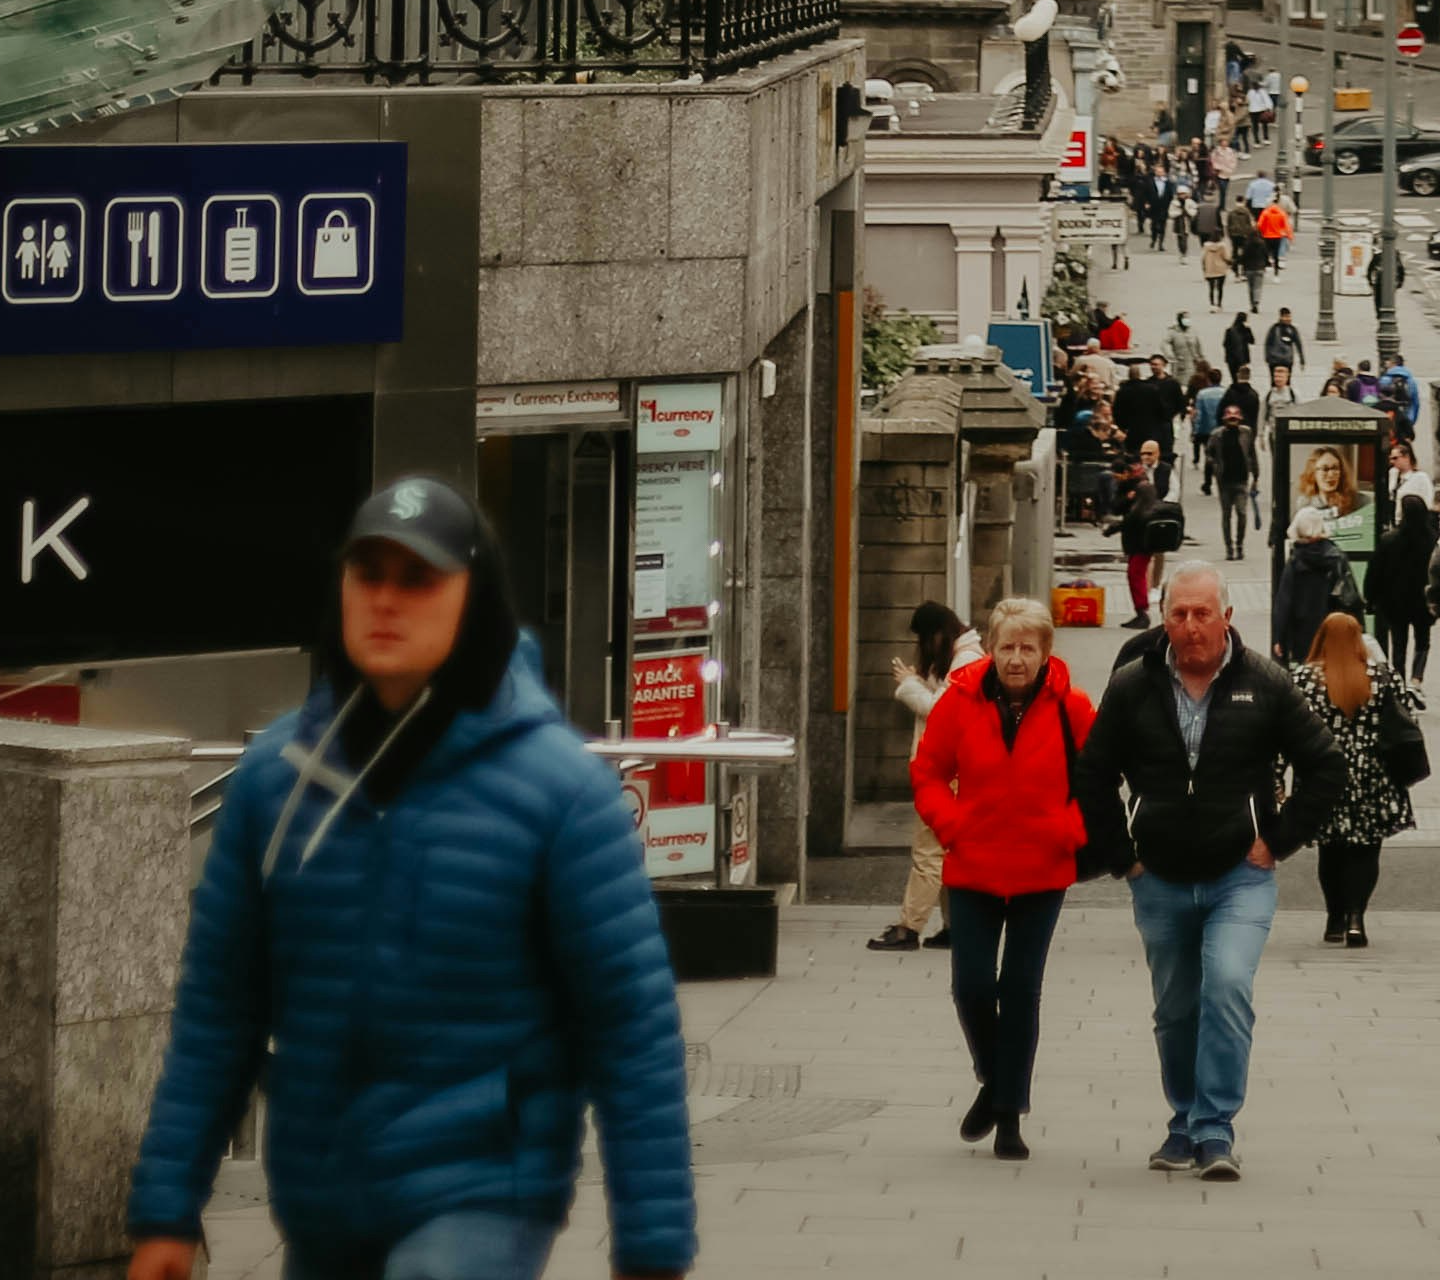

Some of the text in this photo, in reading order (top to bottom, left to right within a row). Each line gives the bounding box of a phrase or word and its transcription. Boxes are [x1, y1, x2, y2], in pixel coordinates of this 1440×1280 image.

[513, 392, 566, 406] Currency
[656, 410, 715, 423] currency
[678, 460, 706, 472] HERE
[633, 667, 683, 685] Y BACK
[633, 684, 696, 704] ARANTEE
